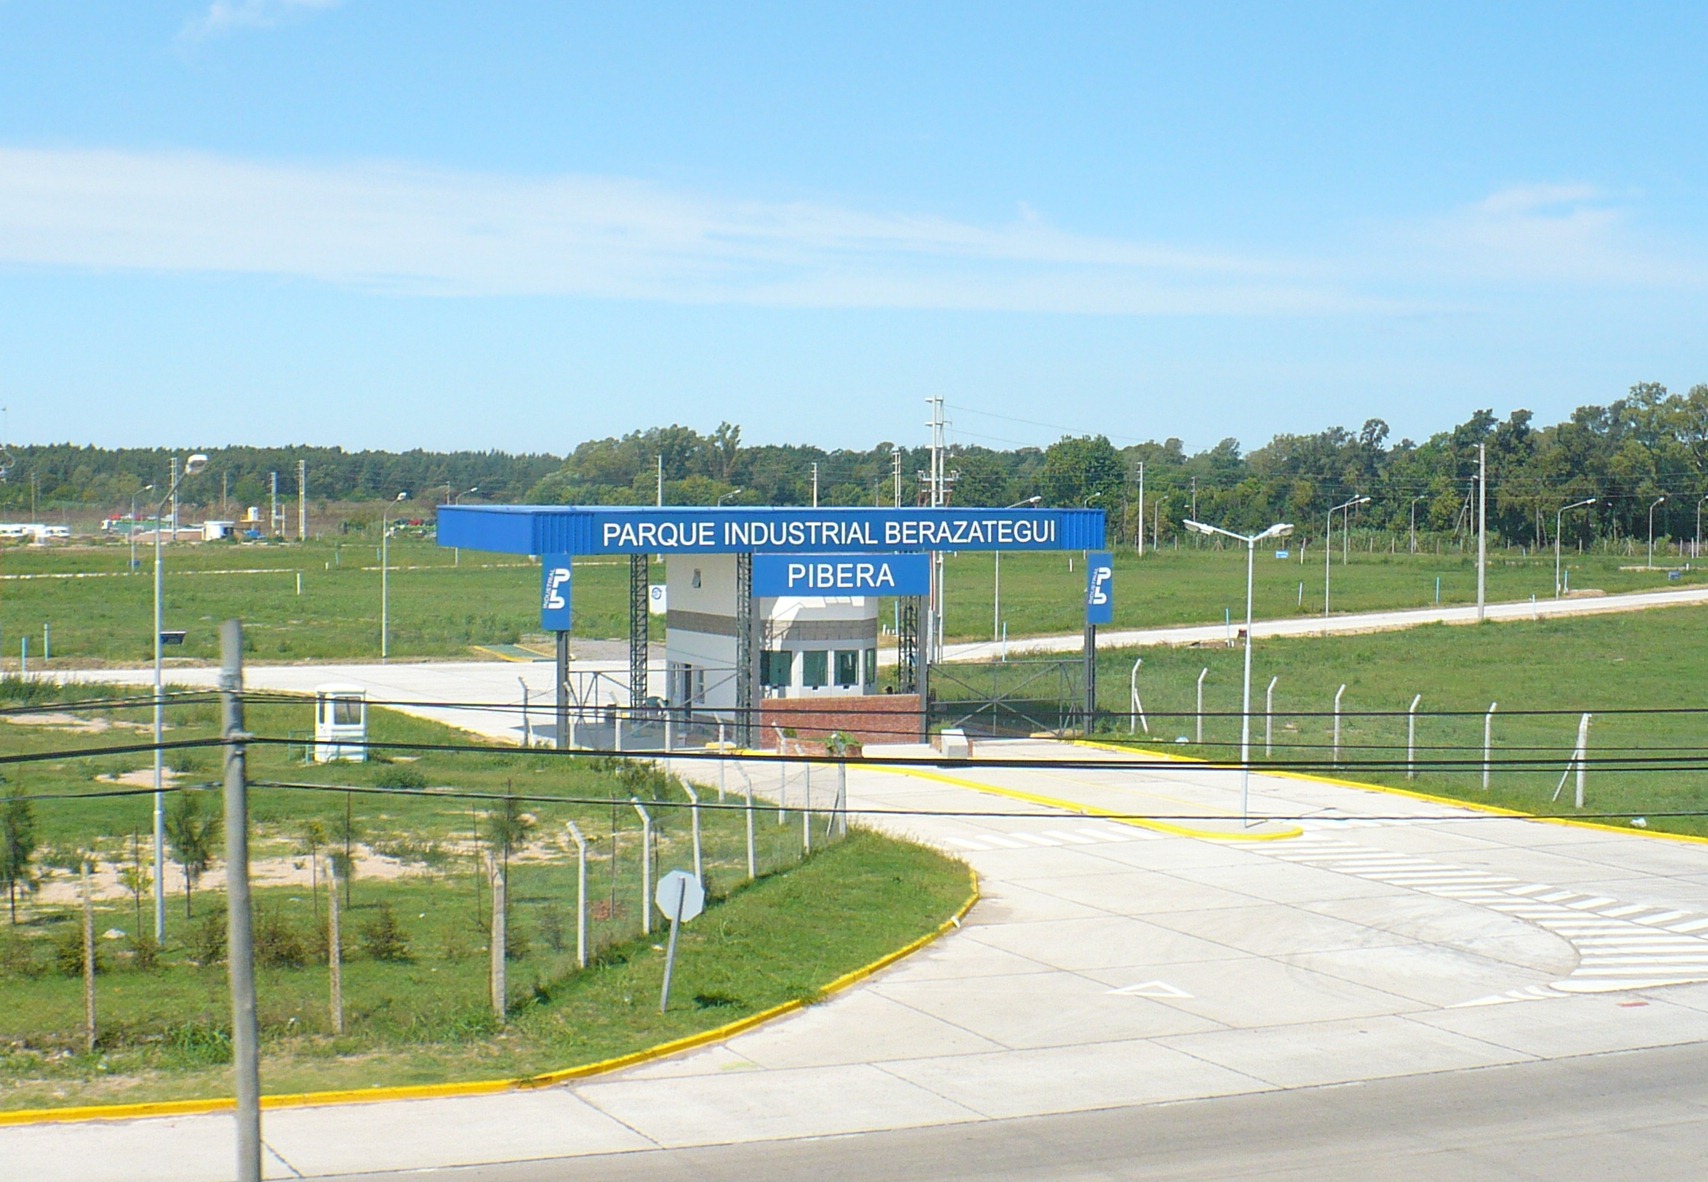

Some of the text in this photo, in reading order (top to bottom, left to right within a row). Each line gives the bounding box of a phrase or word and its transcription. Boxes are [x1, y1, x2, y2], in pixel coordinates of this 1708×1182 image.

[603, 519, 1056, 547] PARQUE INDUSTRIAL BERAZATEGUI
[787, 563, 895, 588] PIBERA
